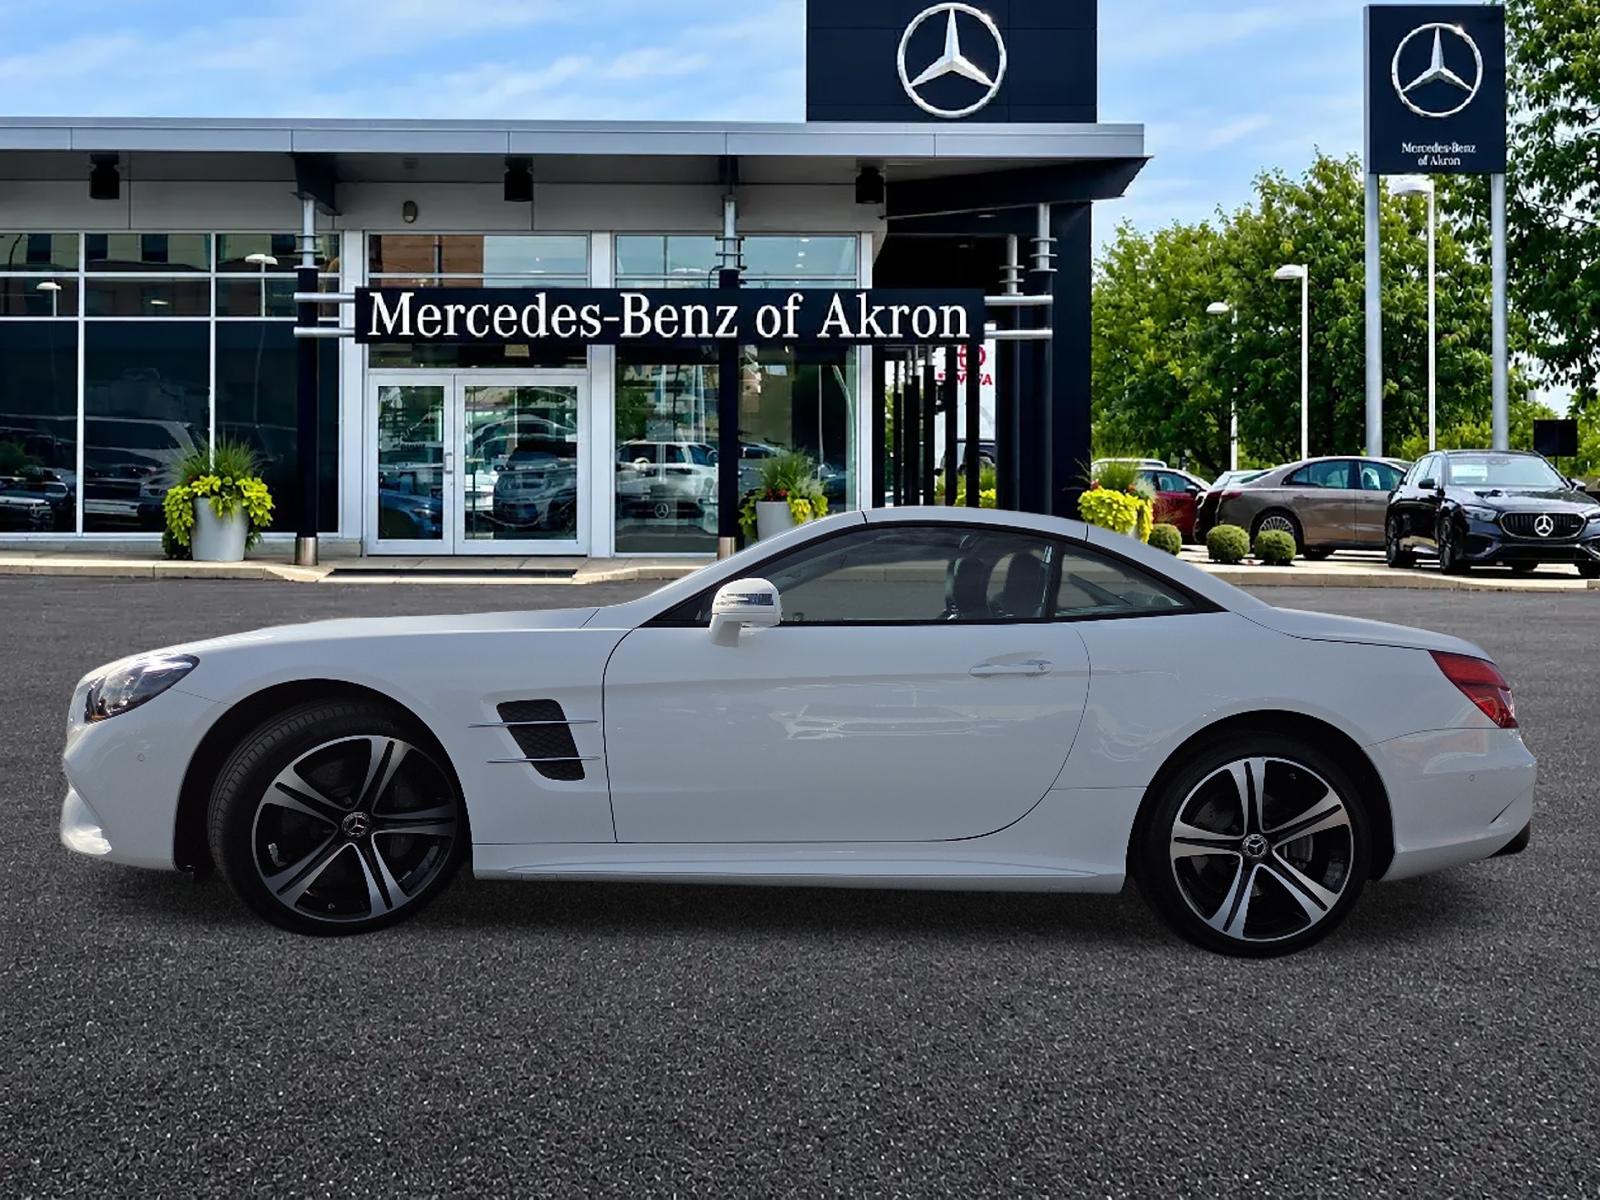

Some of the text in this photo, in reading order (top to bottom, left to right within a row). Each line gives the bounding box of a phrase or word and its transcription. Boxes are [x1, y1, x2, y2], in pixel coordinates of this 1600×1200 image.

[1401, 142, 1477, 153] Mercedes-Benz
[1417, 154, 1461, 166] of Akron
[367, 291, 971, 339] Mercedes-Benz of Akron
